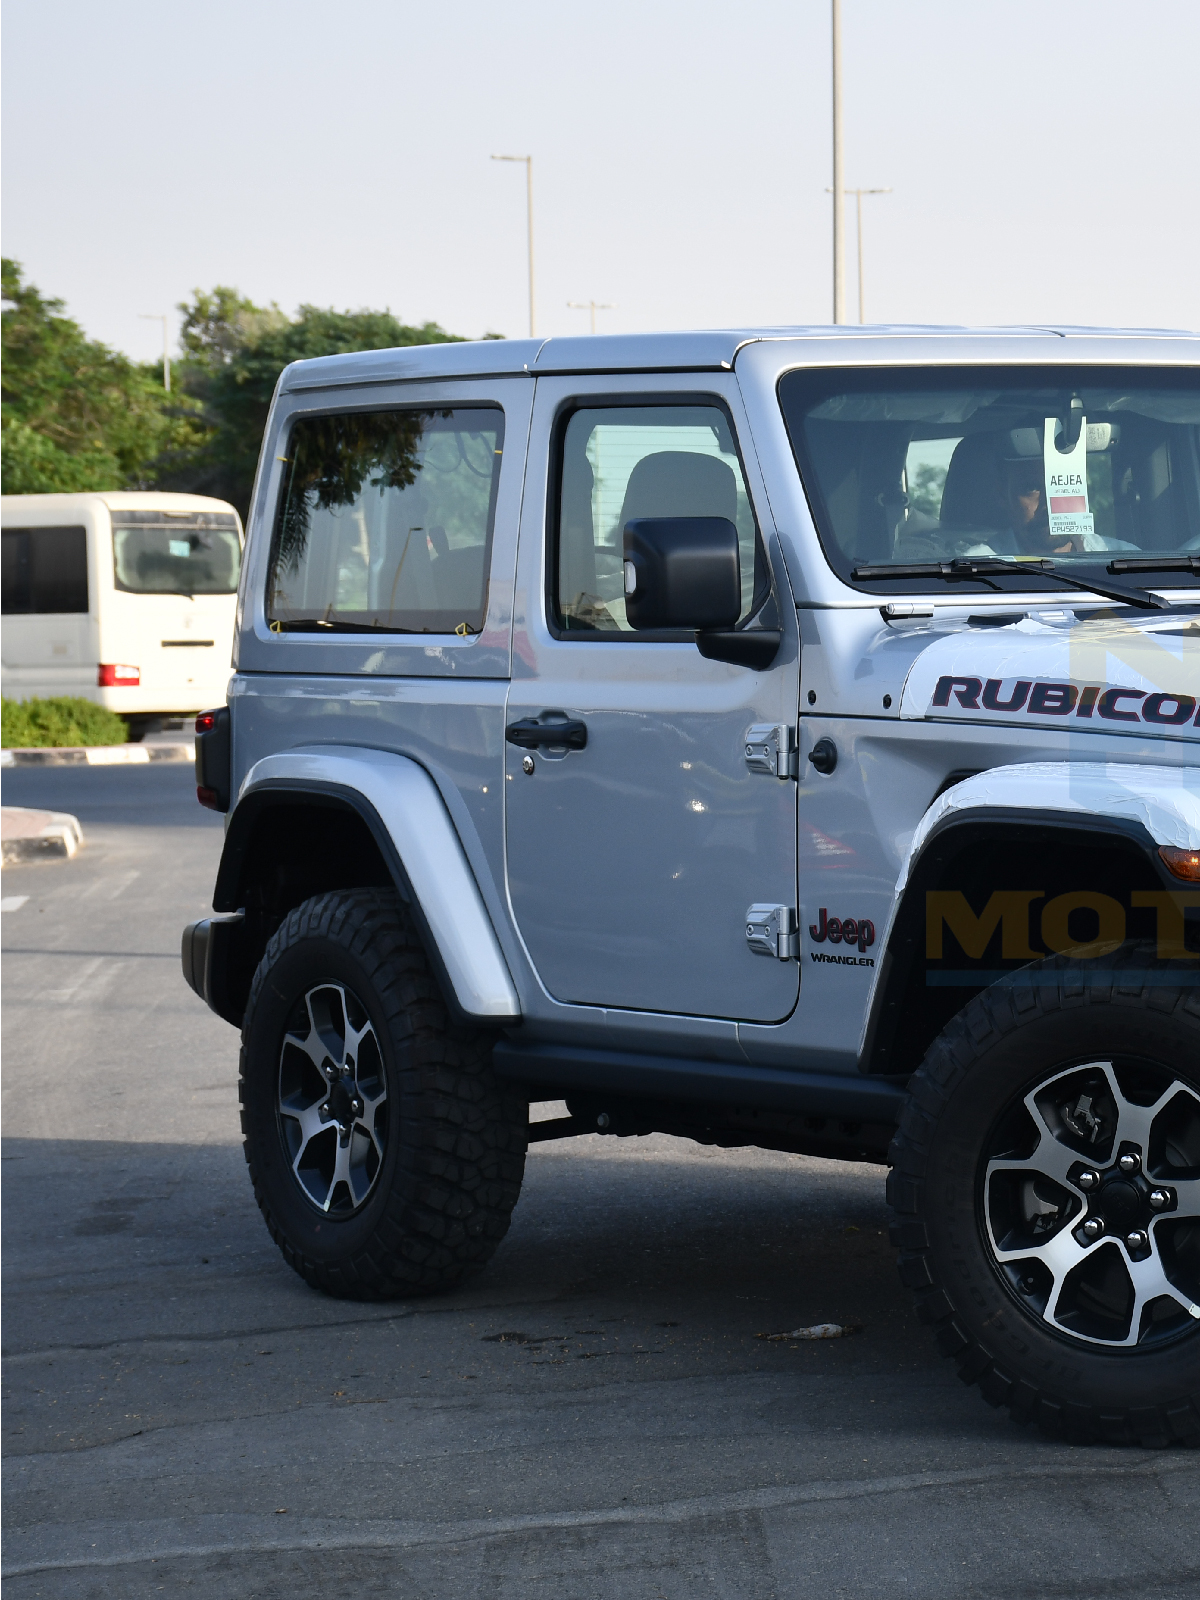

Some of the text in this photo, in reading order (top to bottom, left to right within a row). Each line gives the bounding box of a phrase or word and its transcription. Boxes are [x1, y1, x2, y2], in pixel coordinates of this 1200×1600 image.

[1050, 474, 1083, 486] AEJEA
[809, 907, 876, 953] Jeep
[811, 952, 875, 967] WRANGLER
